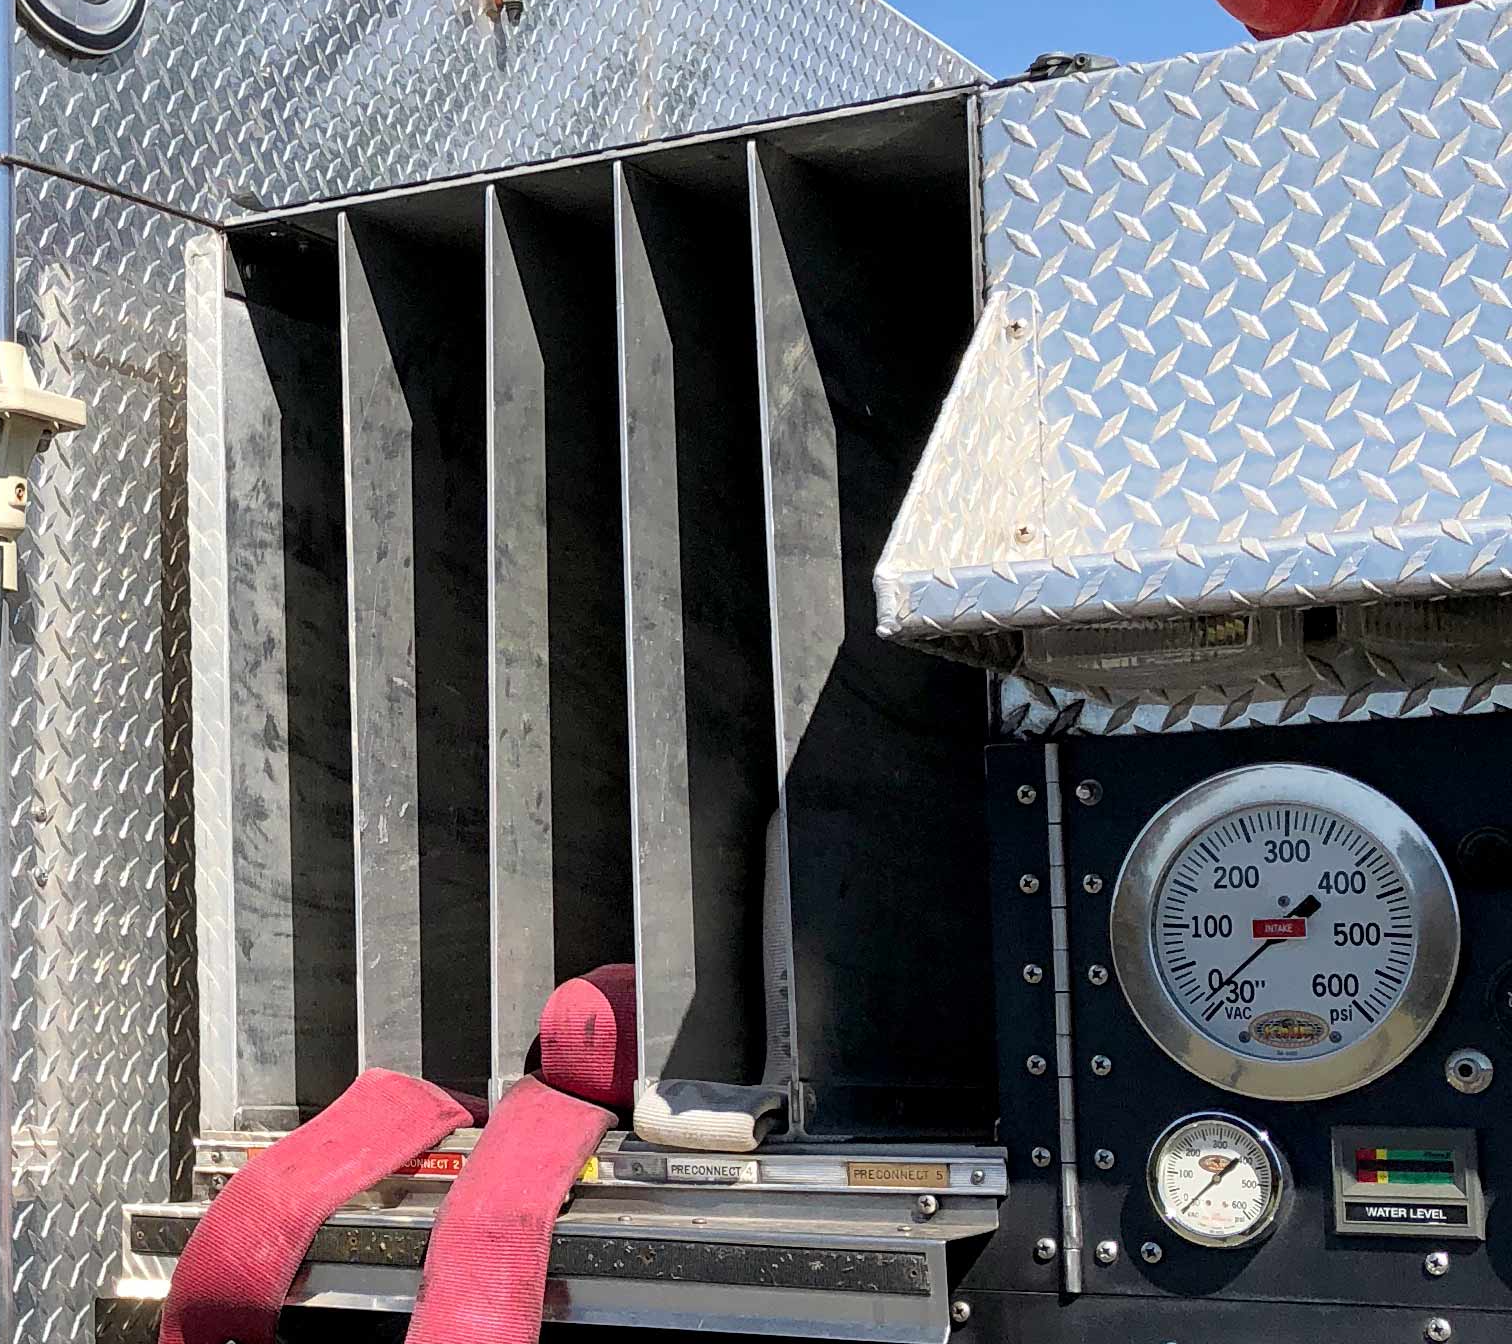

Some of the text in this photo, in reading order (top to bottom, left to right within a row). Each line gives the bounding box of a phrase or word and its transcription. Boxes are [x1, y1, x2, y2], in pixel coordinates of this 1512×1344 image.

[1264, 839, 1310, 863] 300
[1214, 866, 1259, 888] 200
[1318, 870, 1366, 894] 400
[1191, 915, 1232, 938] 100
[1264, 924, 1293, 933] INTAKE
[1334, 922, 1380, 946] 500
[1208, 969, 1223, 992] 0
[1312, 974, 1358, 997] 600
[1226, 1006, 1252, 1020] VAC
[1330, 1005, 1352, 1024] psi
[1213, 1140, 1227, 1149] 300
[1186, 1149, 1200, 1157] 200
[401, 1158, 460, 1169] CONNECT 2
[671, 1164, 742, 1178] PRECONNECT
[853, 1170, 943, 1181] PRECONNECT 5
[1179, 1170, 1193, 1178] 100
[1242, 1180, 1256, 1188] 500
[1365, 1207, 1447, 1220] WATER LEVEL
